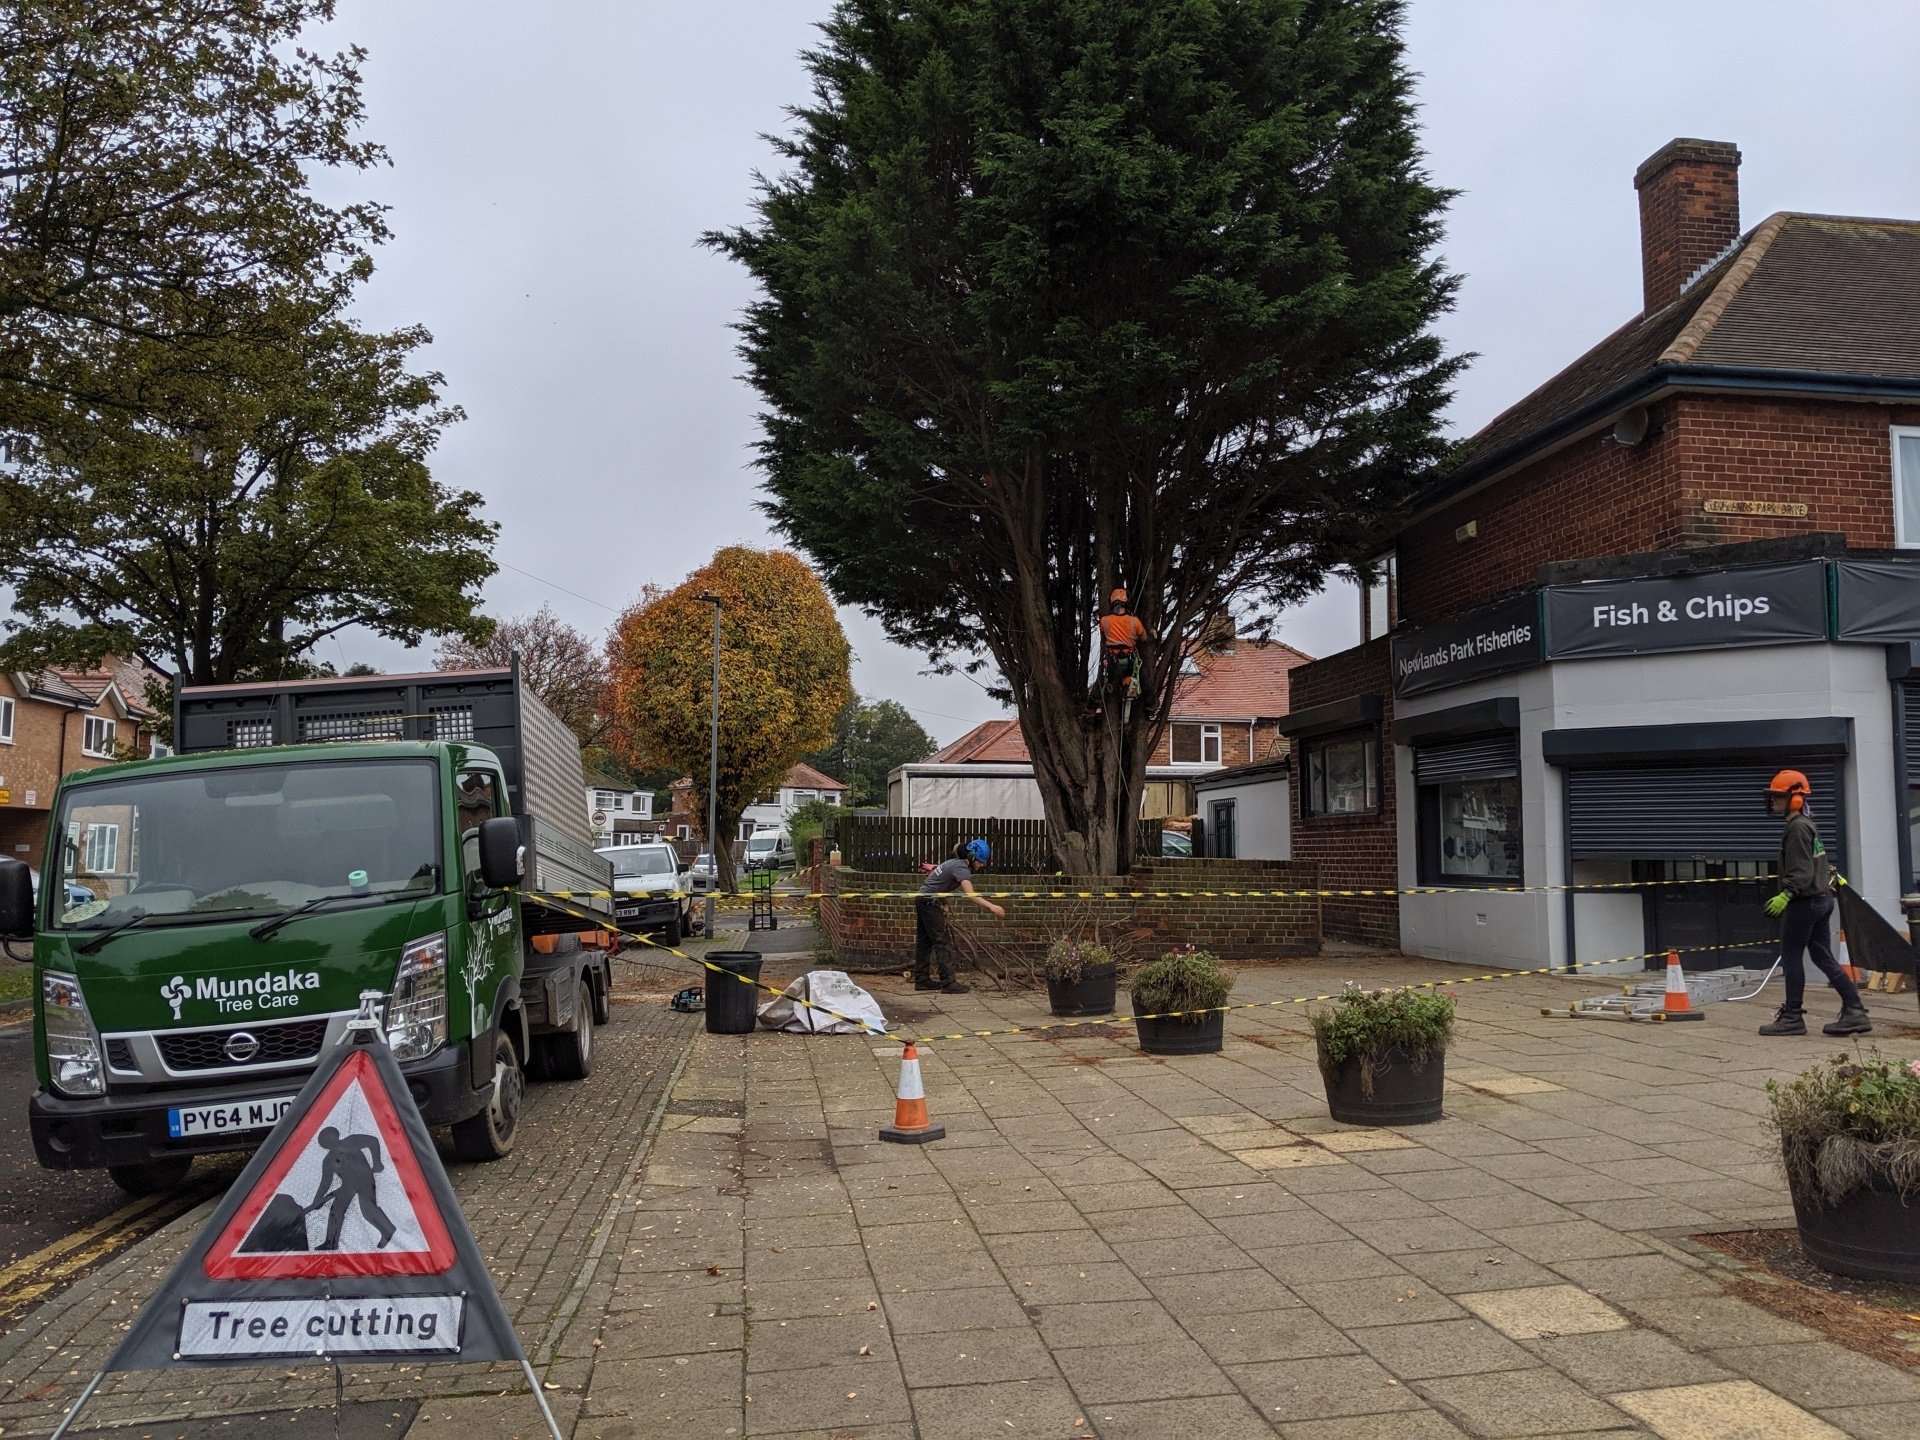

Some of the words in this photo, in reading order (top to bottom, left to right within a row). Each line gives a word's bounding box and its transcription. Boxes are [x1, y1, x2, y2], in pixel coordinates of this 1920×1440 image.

[1593, 603, 1649, 627] Fish
[1657, 600, 1679, 622] &
[1686, 594, 1770, 622] Chips
[1400, 647, 1449, 676] Newlands
[1450, 638, 1476, 662] Park
[1476, 624, 1532, 655] Fisheries
[196, 969, 320, 1000] Mundaka
[215, 998, 253, 1013] Tree
[258, 994, 299, 1009] Care
[183, 1107, 242, 1132] PY64
[208, 1311, 289, 1340] Tree
[306, 1307, 438, 1340] cutting
